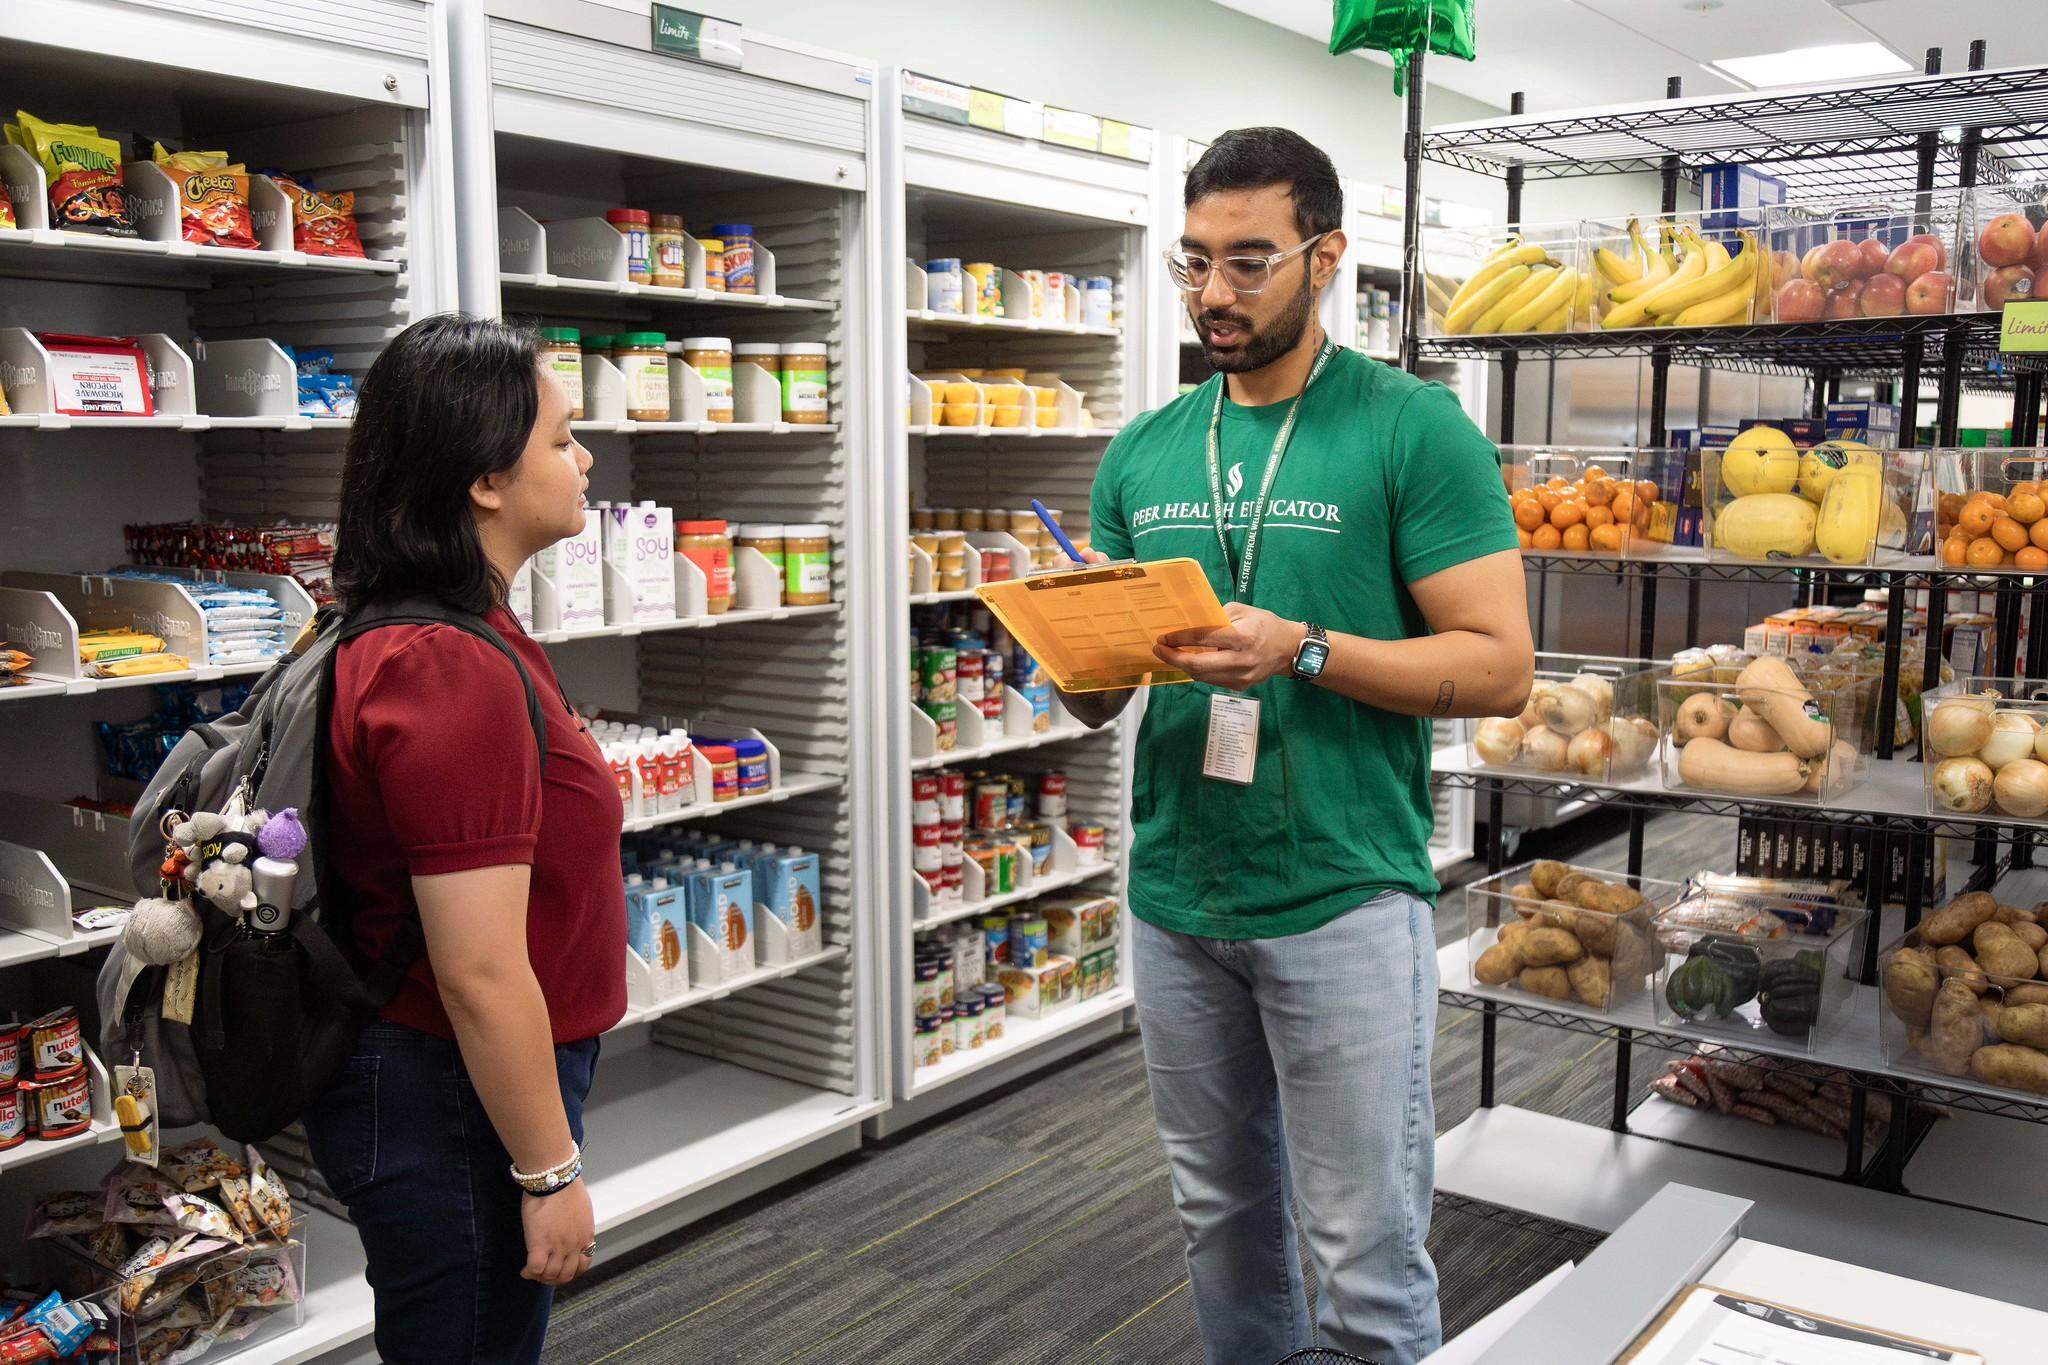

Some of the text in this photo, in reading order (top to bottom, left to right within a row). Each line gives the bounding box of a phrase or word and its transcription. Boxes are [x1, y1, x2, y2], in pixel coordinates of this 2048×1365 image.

[185, 174, 236, 203] Cheetos
[75, 389, 124, 399] MICROWAVE
[79, 381, 117, 391] POPCORN
[1260, 454, 1279, 497] AMBASSADOR
[1133, 505, 1161, 528] PEER
[1163, 502, 1234, 519] HEALH
[1251, 497, 1265, 531] WELLNESS
[1245, 531, 1257, 560] OFFICIAL
[1241, 561, 1252, 581] STATE
[1239, 581, 1248, 593] SAC
